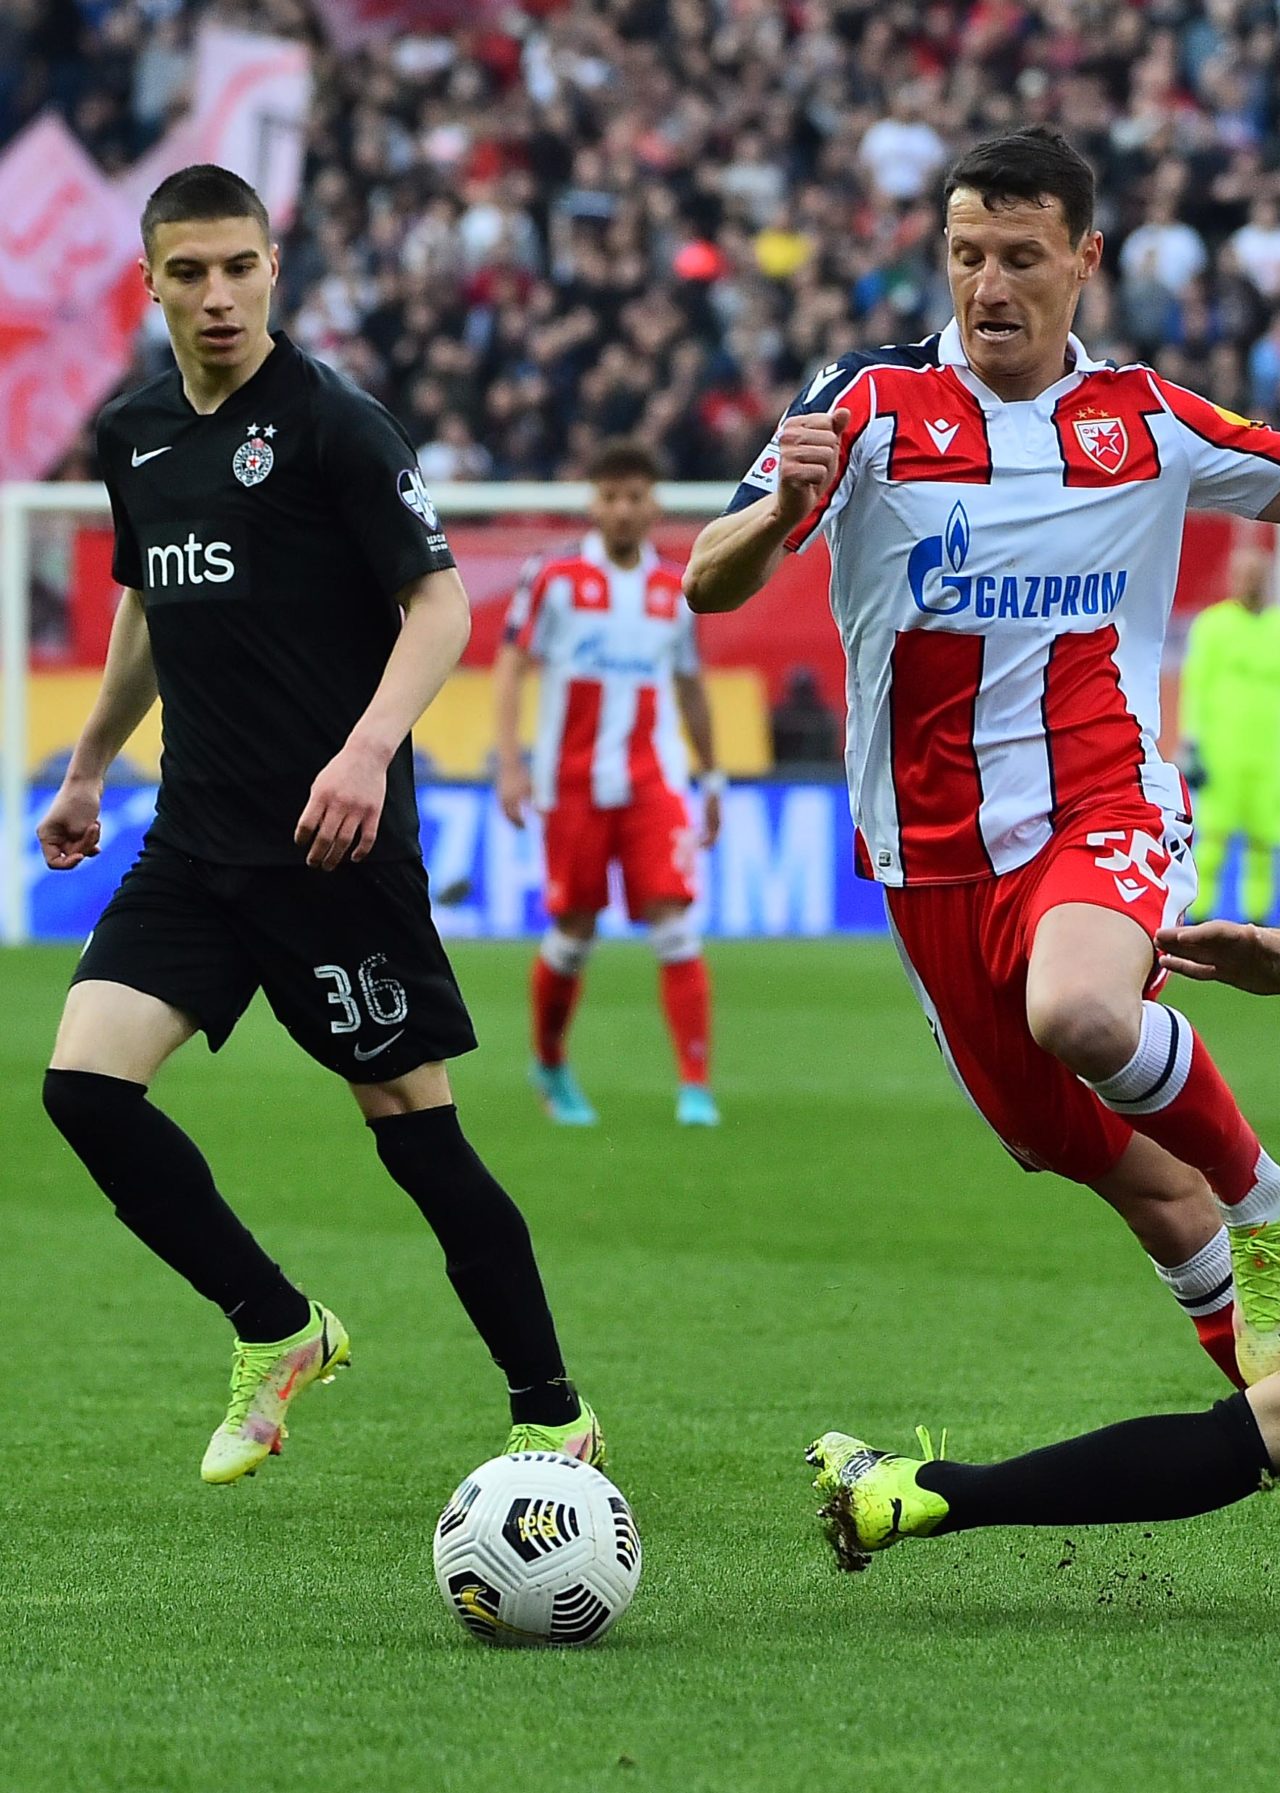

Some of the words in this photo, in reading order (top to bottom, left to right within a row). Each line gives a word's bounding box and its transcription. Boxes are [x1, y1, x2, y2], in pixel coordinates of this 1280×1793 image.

[147, 532, 235, 588] mts
[975, 570, 1128, 619] GAZPROM
[313, 952, 408, 1034] 36
